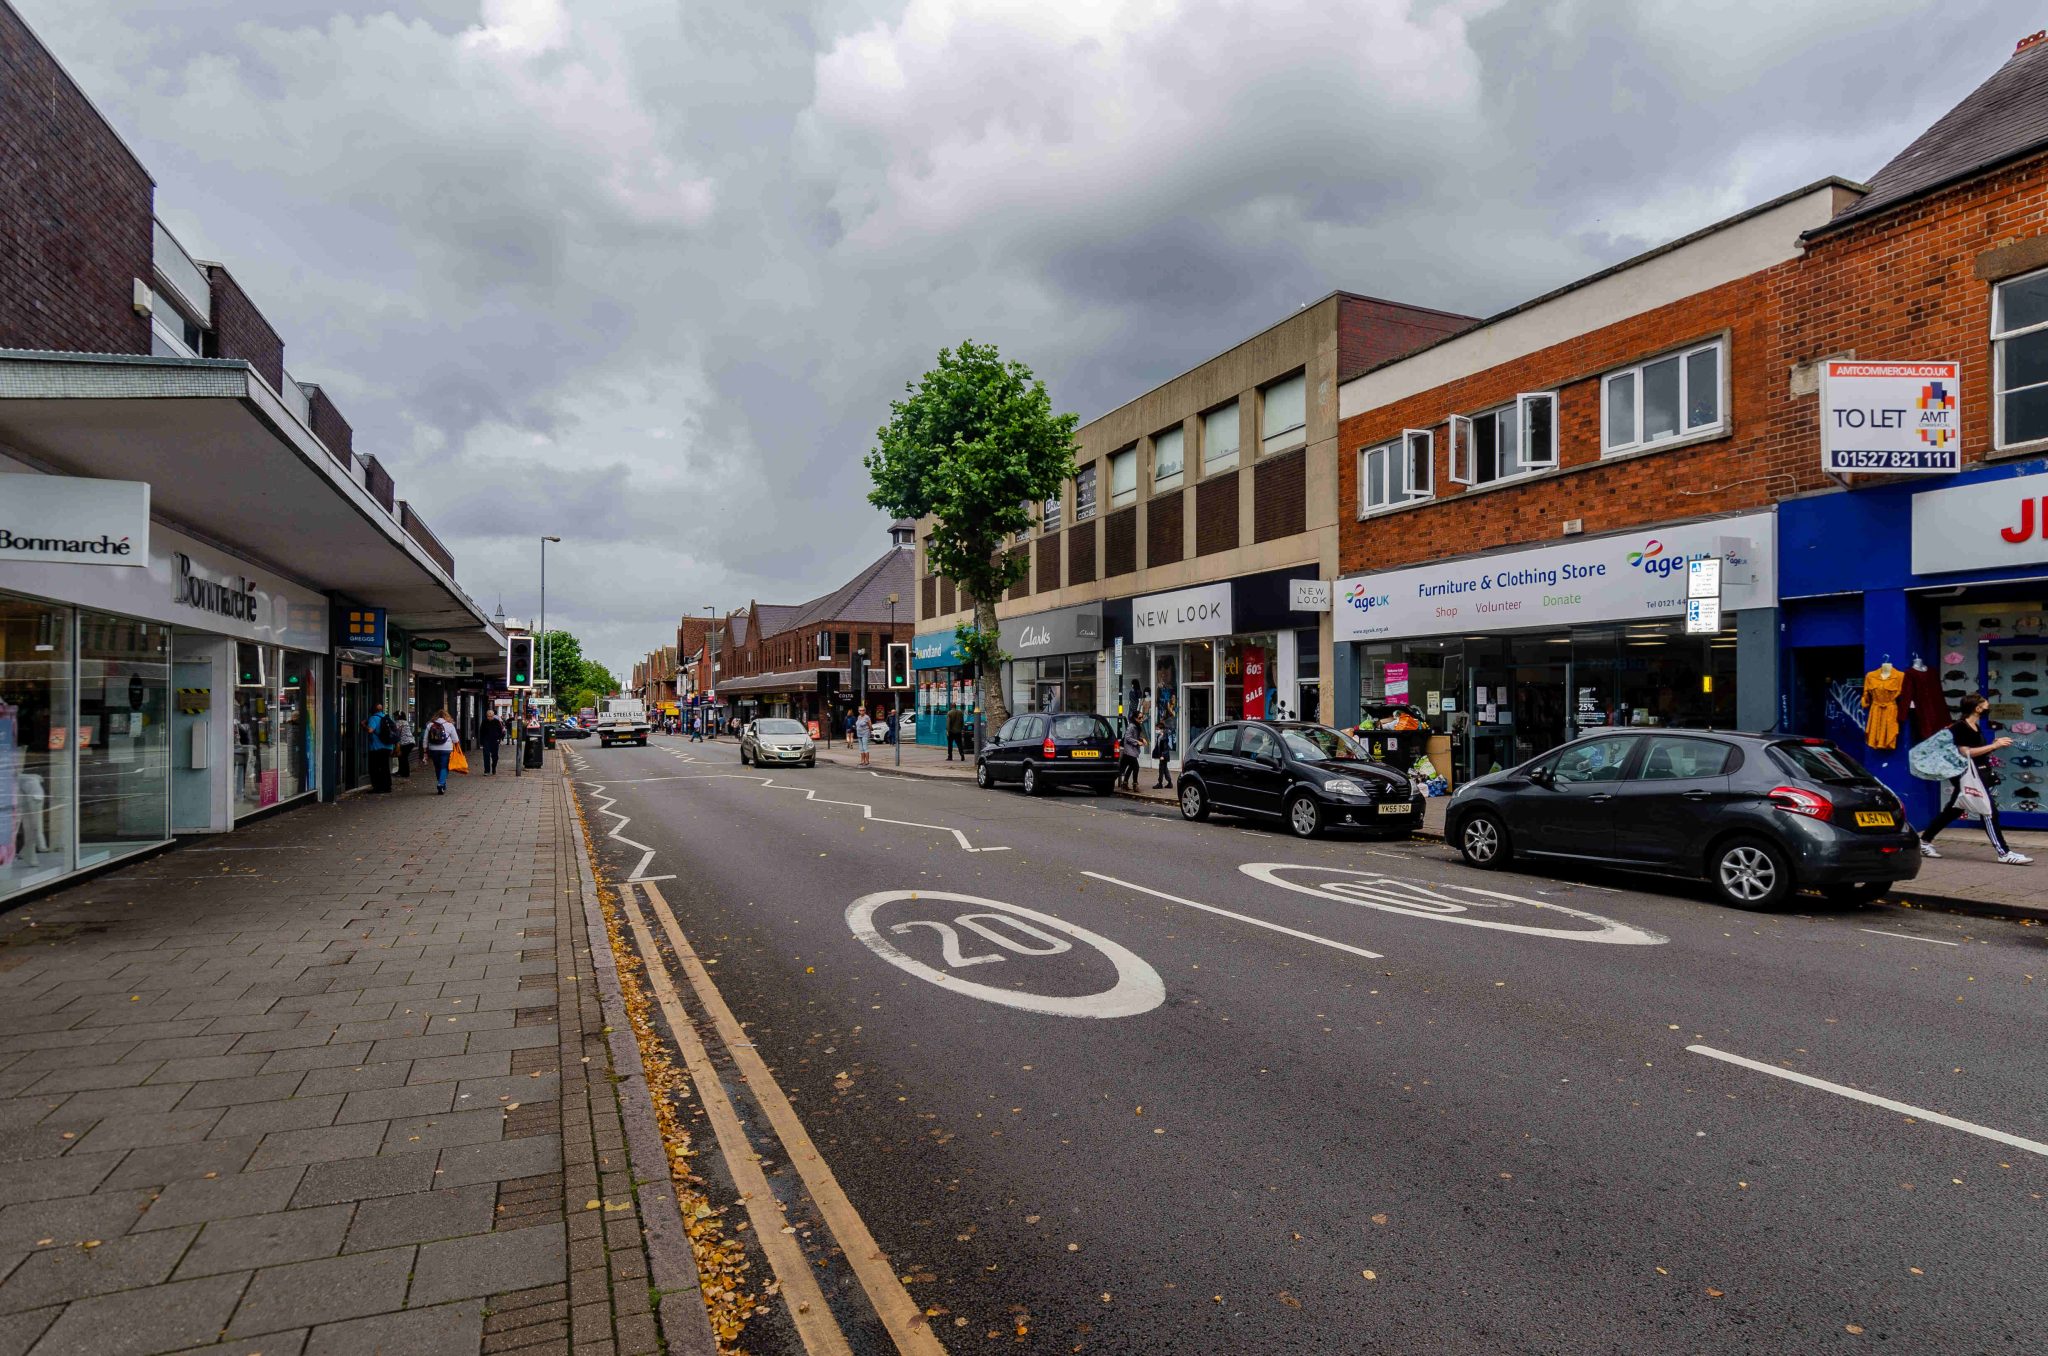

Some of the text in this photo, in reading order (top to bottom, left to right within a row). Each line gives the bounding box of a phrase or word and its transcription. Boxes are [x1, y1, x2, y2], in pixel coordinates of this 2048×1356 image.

[1836, 366, 1949, 376] AMTCOMMERCIAL.CO.UK
[1833, 408, 1907, 428] TO LET
[1920, 411, 1950, 423] AMT
[1837, 451, 1950, 467] 01527 821 111
[0, 529, 130, 555] Bonmarché
[1419, 563, 1606, 597] Furniture & Clothing Store
[1297, 596, 1327, 604] LOOK
[1299, 587, 1325, 596] NEW
[1137, 602, 1221, 628] NEW LOOK
[1435, 593, 1581, 619] Shop Volunteer Donate
[1019, 626, 1051, 648] Clarks
[1245, 687, 1263, 703] SALE
[1578, 703, 1595, 711] 25%
[890, 913, 1073, 967] 20
